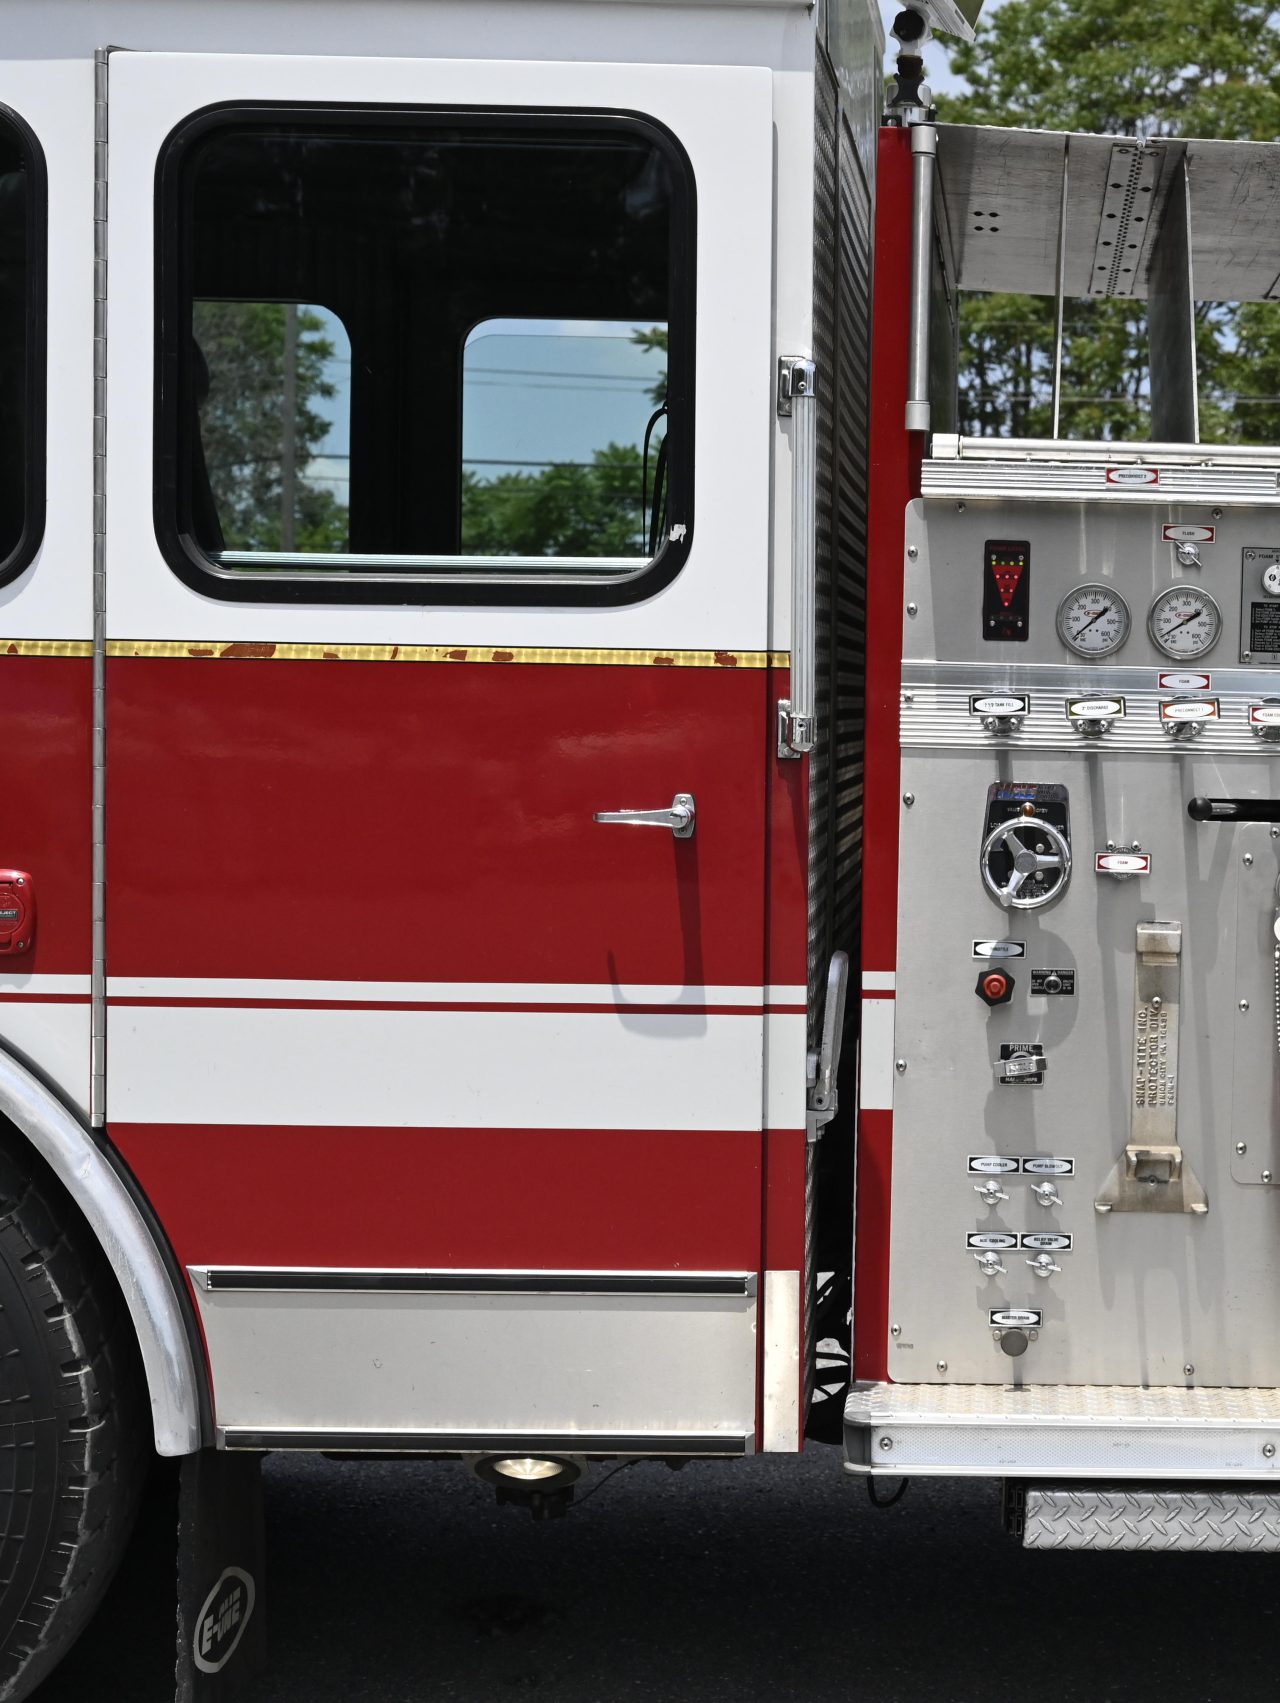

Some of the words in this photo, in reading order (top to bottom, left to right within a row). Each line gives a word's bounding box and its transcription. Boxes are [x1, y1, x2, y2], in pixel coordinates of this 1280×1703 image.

[1137, 1006, 1148, 1031] INC.
[1009, 1044, 1034, 1052] PRIME
[1136, 1037, 1147, 1105] SNAP-TITE
[1148, 1034, 1159, 1105] PROTECTOR
